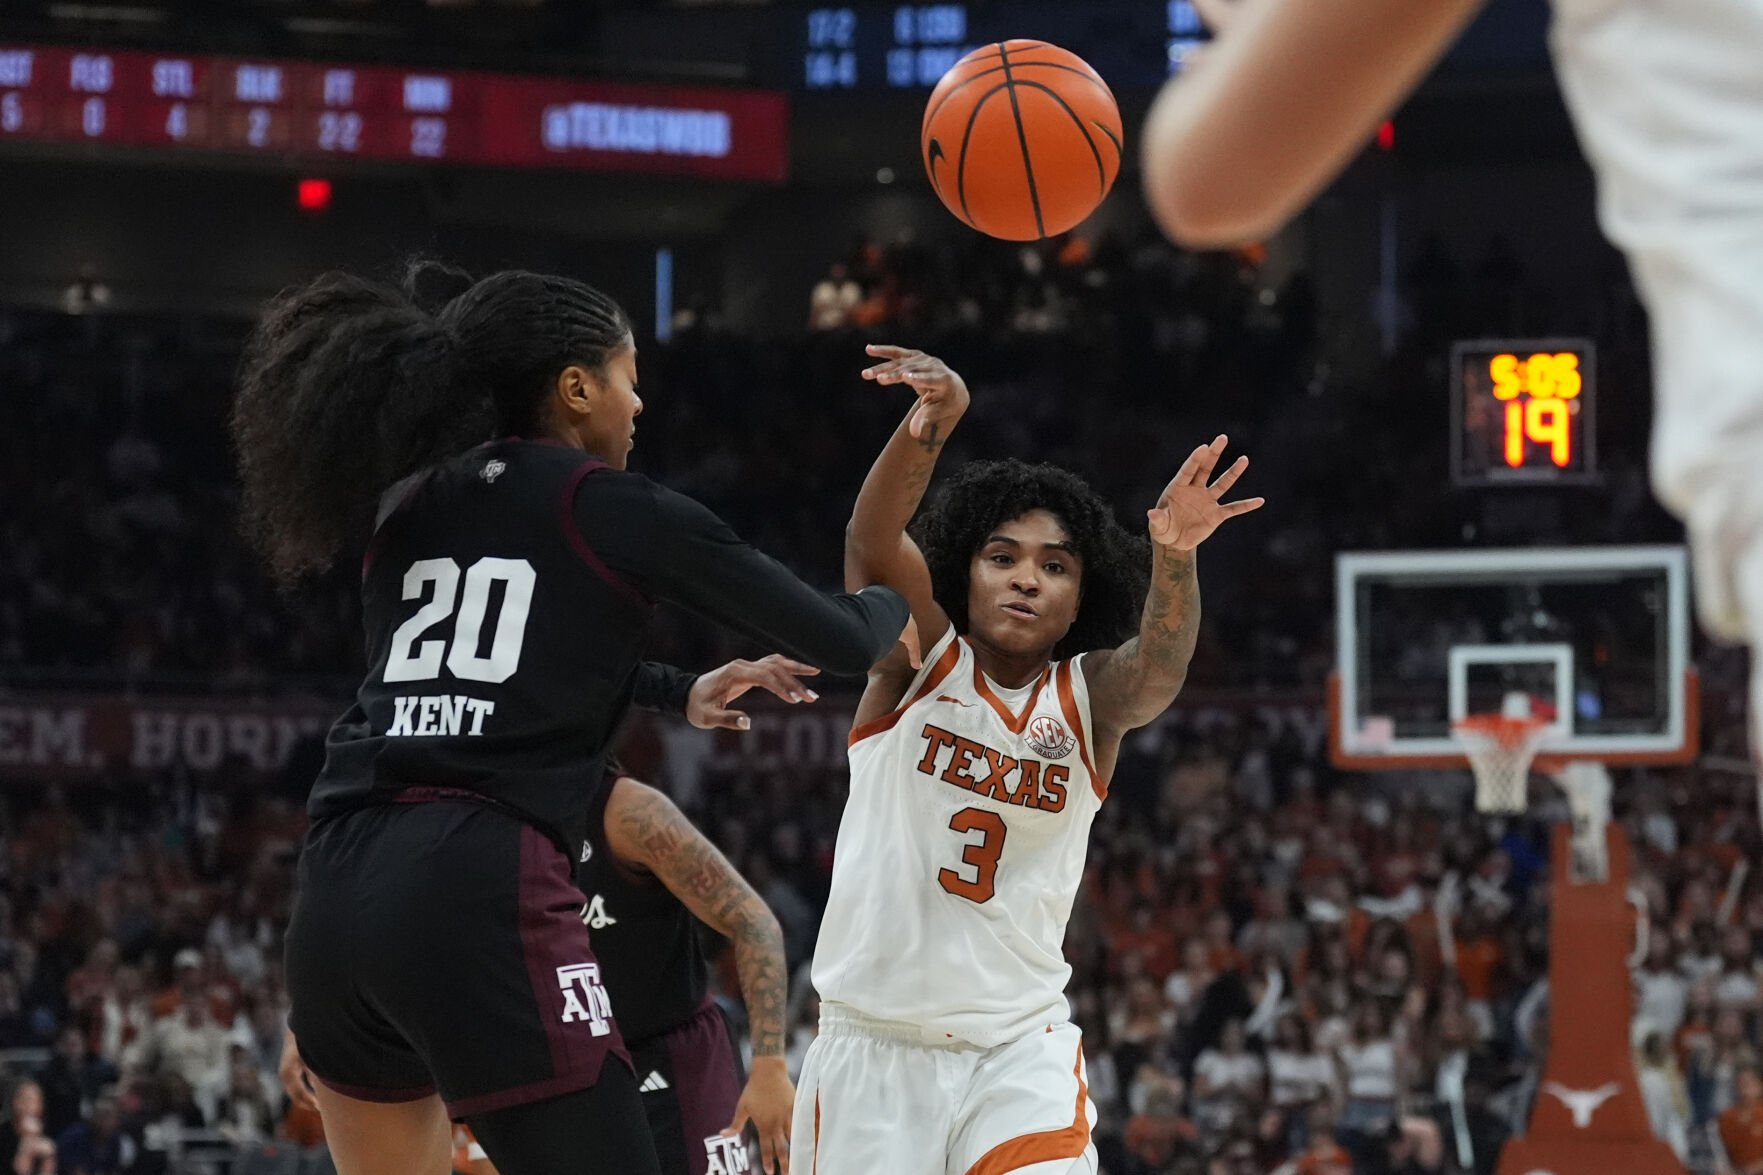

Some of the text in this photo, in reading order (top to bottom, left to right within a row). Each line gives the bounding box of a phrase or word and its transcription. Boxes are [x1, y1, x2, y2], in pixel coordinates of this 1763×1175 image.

[1490, 353, 1581, 400] 5:05
[1505, 399, 1569, 467] 19
[383, 557, 536, 683] 20
[385, 695, 495, 736] KENT
[1030, 717, 1064, 748] SEC
[917, 723, 1070, 813] TEXAS
[1031, 744, 1072, 758] GRADUATE
[938, 807, 1007, 904] 3
